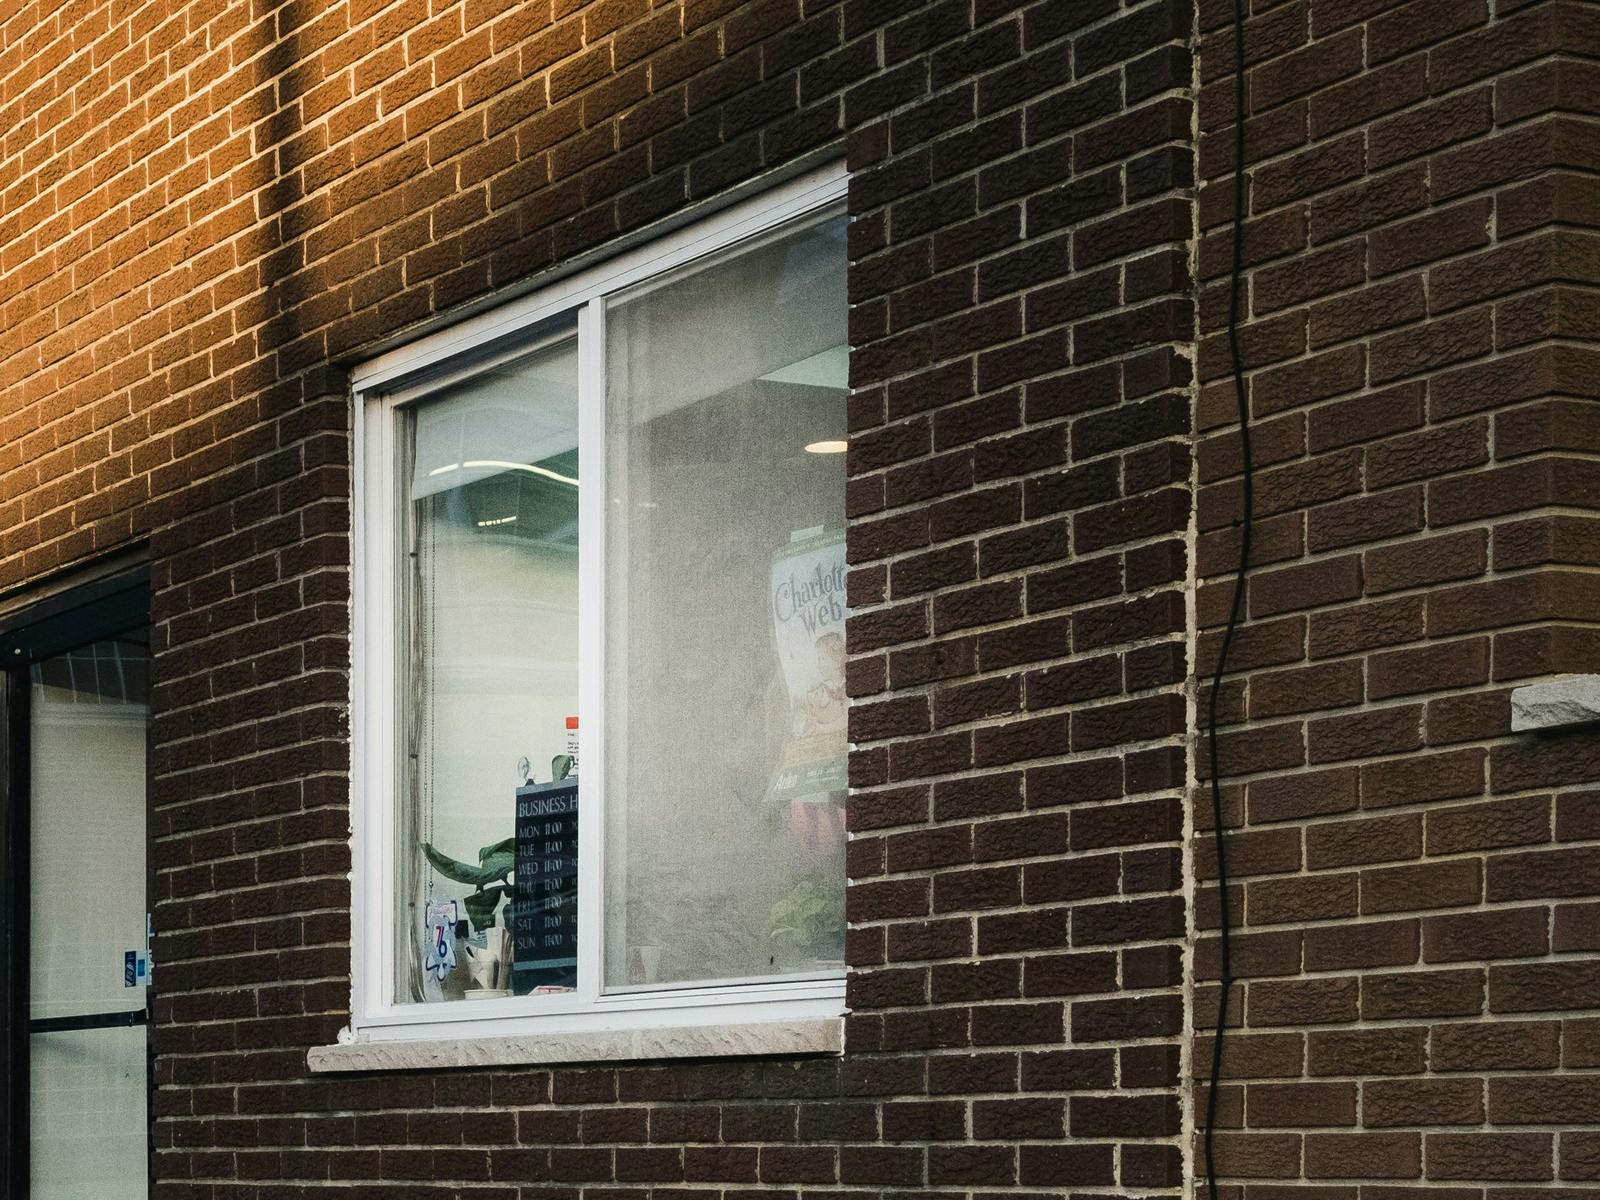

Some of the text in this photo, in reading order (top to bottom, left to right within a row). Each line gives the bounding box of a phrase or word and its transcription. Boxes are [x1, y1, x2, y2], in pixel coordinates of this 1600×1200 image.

[519, 796, 566, 818] BUSINESS
[519, 825, 540, 839] MON
[519, 844, 535, 857] TUE
[518, 862, 538, 876] WED
[518, 918, 532, 931] SAT
[517, 937, 536, 950] SUN
